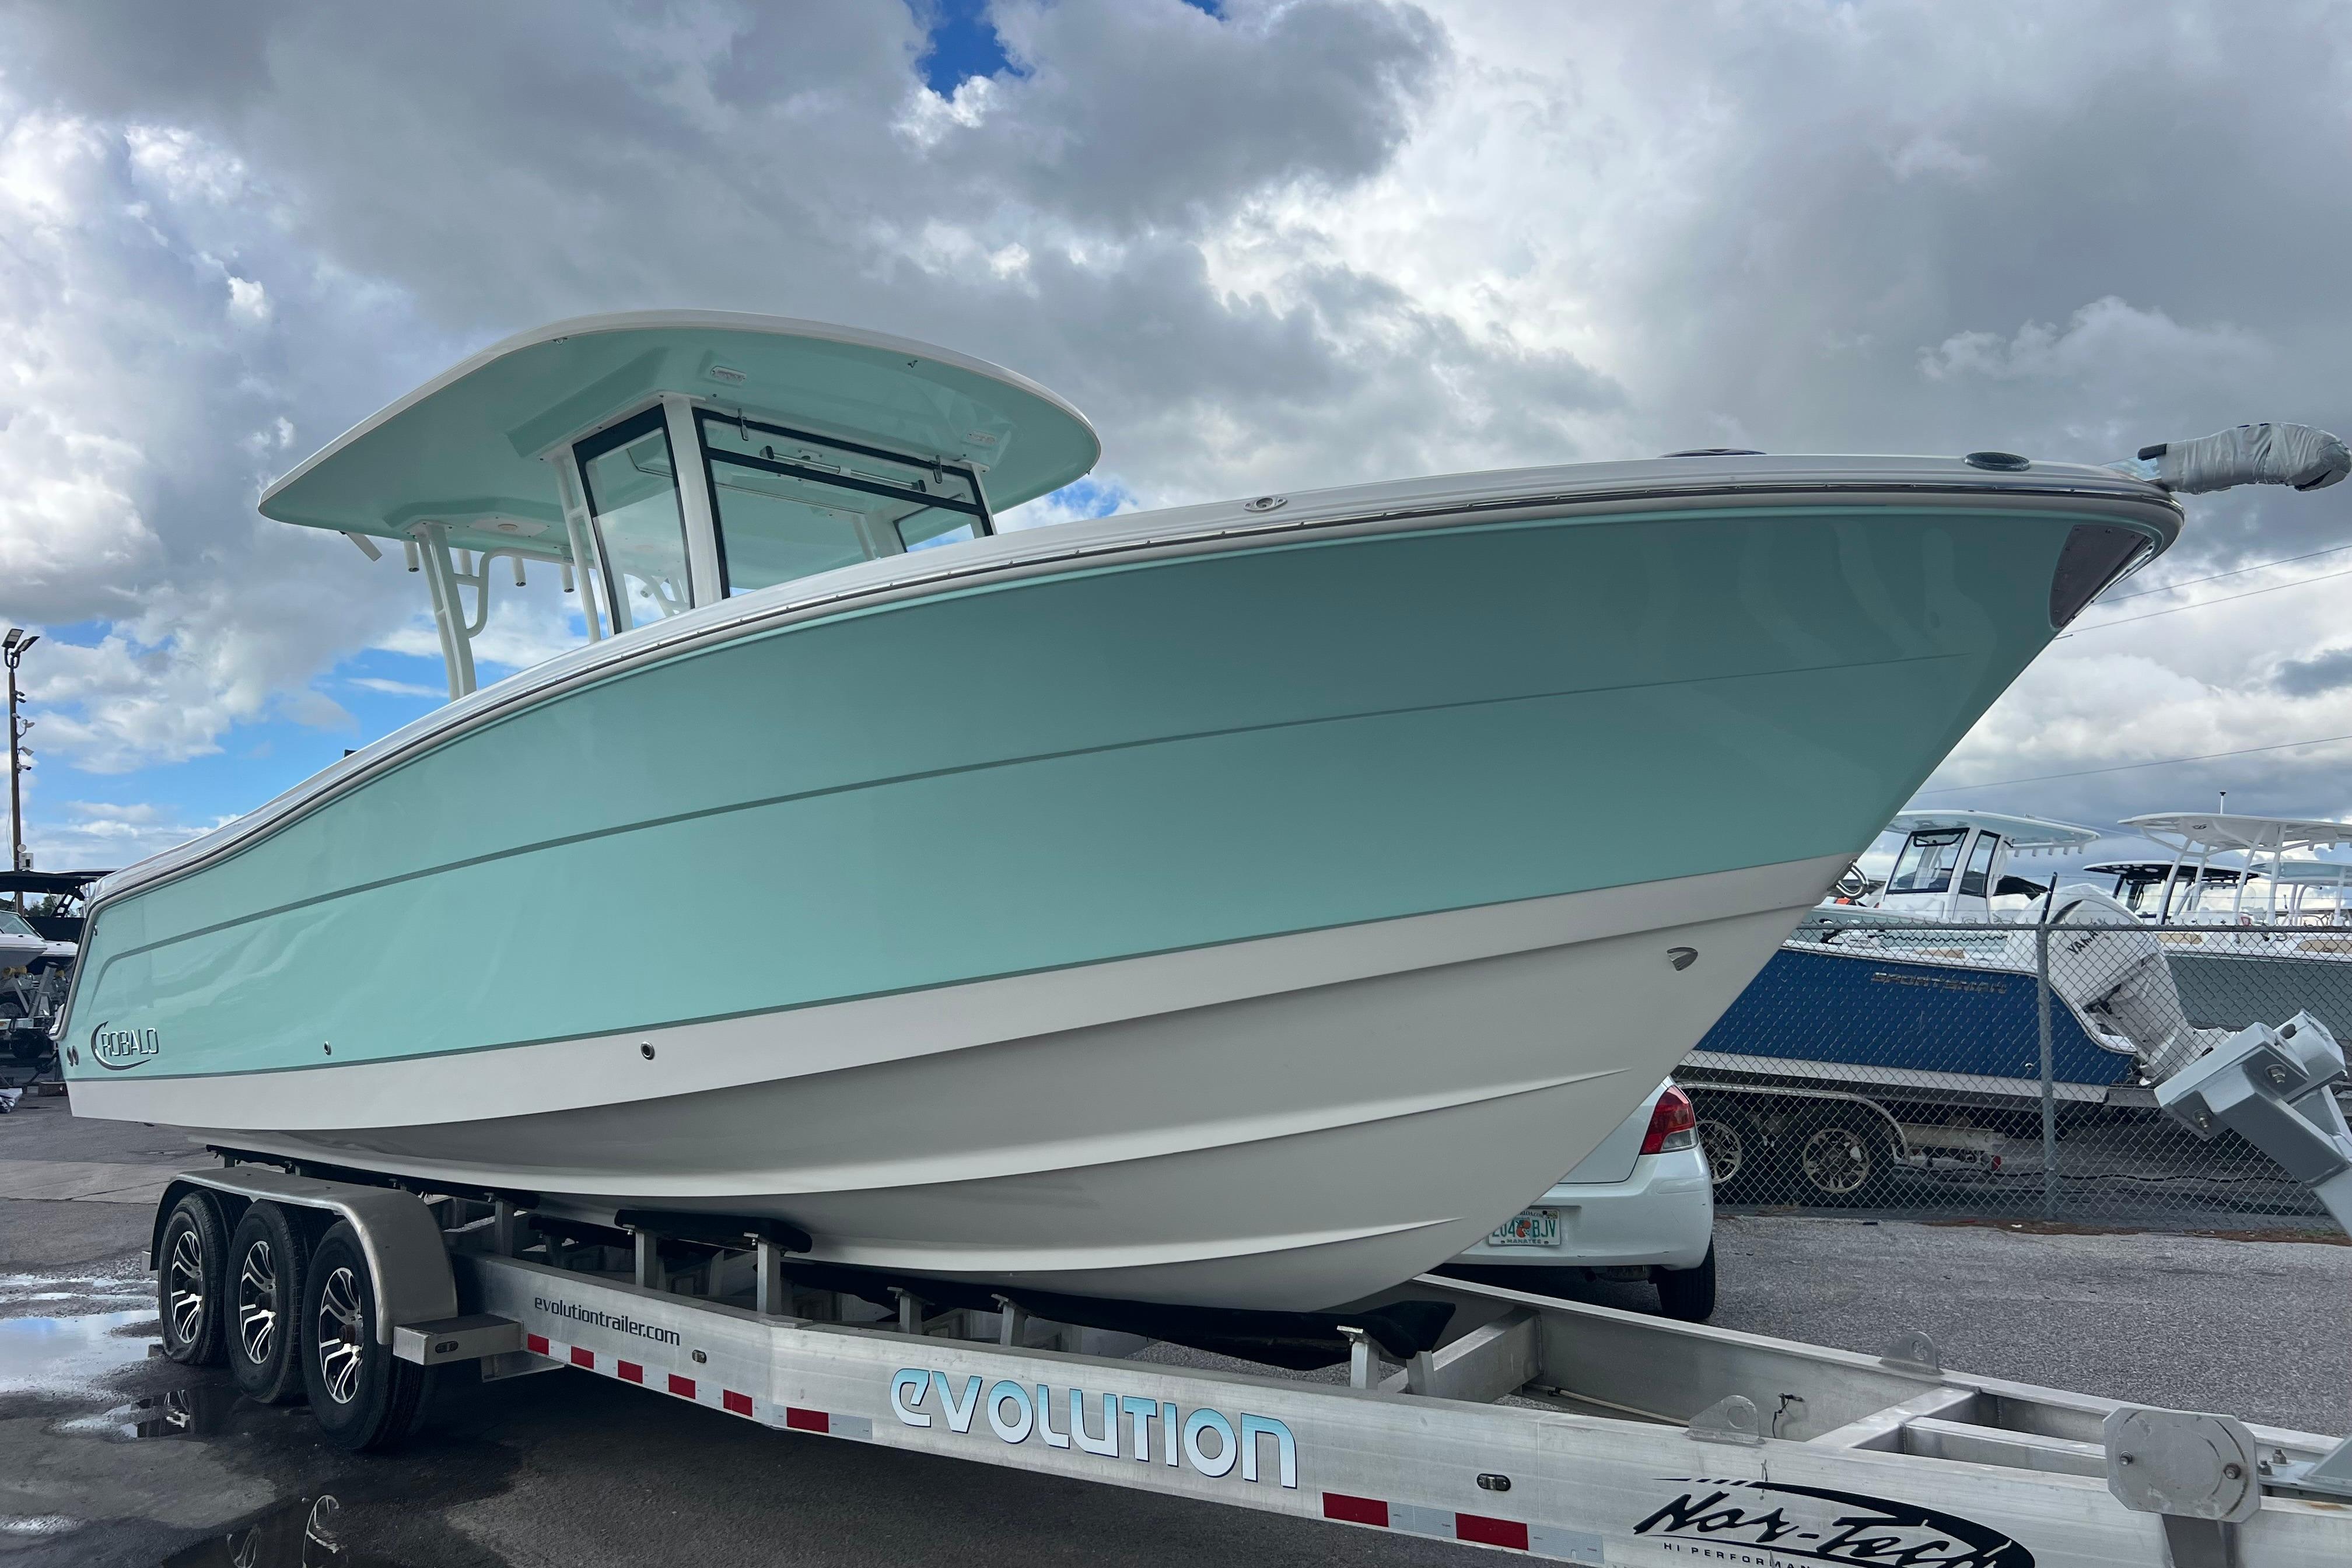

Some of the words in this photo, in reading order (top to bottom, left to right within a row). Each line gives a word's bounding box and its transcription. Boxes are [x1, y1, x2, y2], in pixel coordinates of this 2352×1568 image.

[101, 1027, 159, 1057] ROBALO
[534, 1297, 680, 1346] evolutiontrailer.com
[1664, 1542, 1680, 1552] HI
